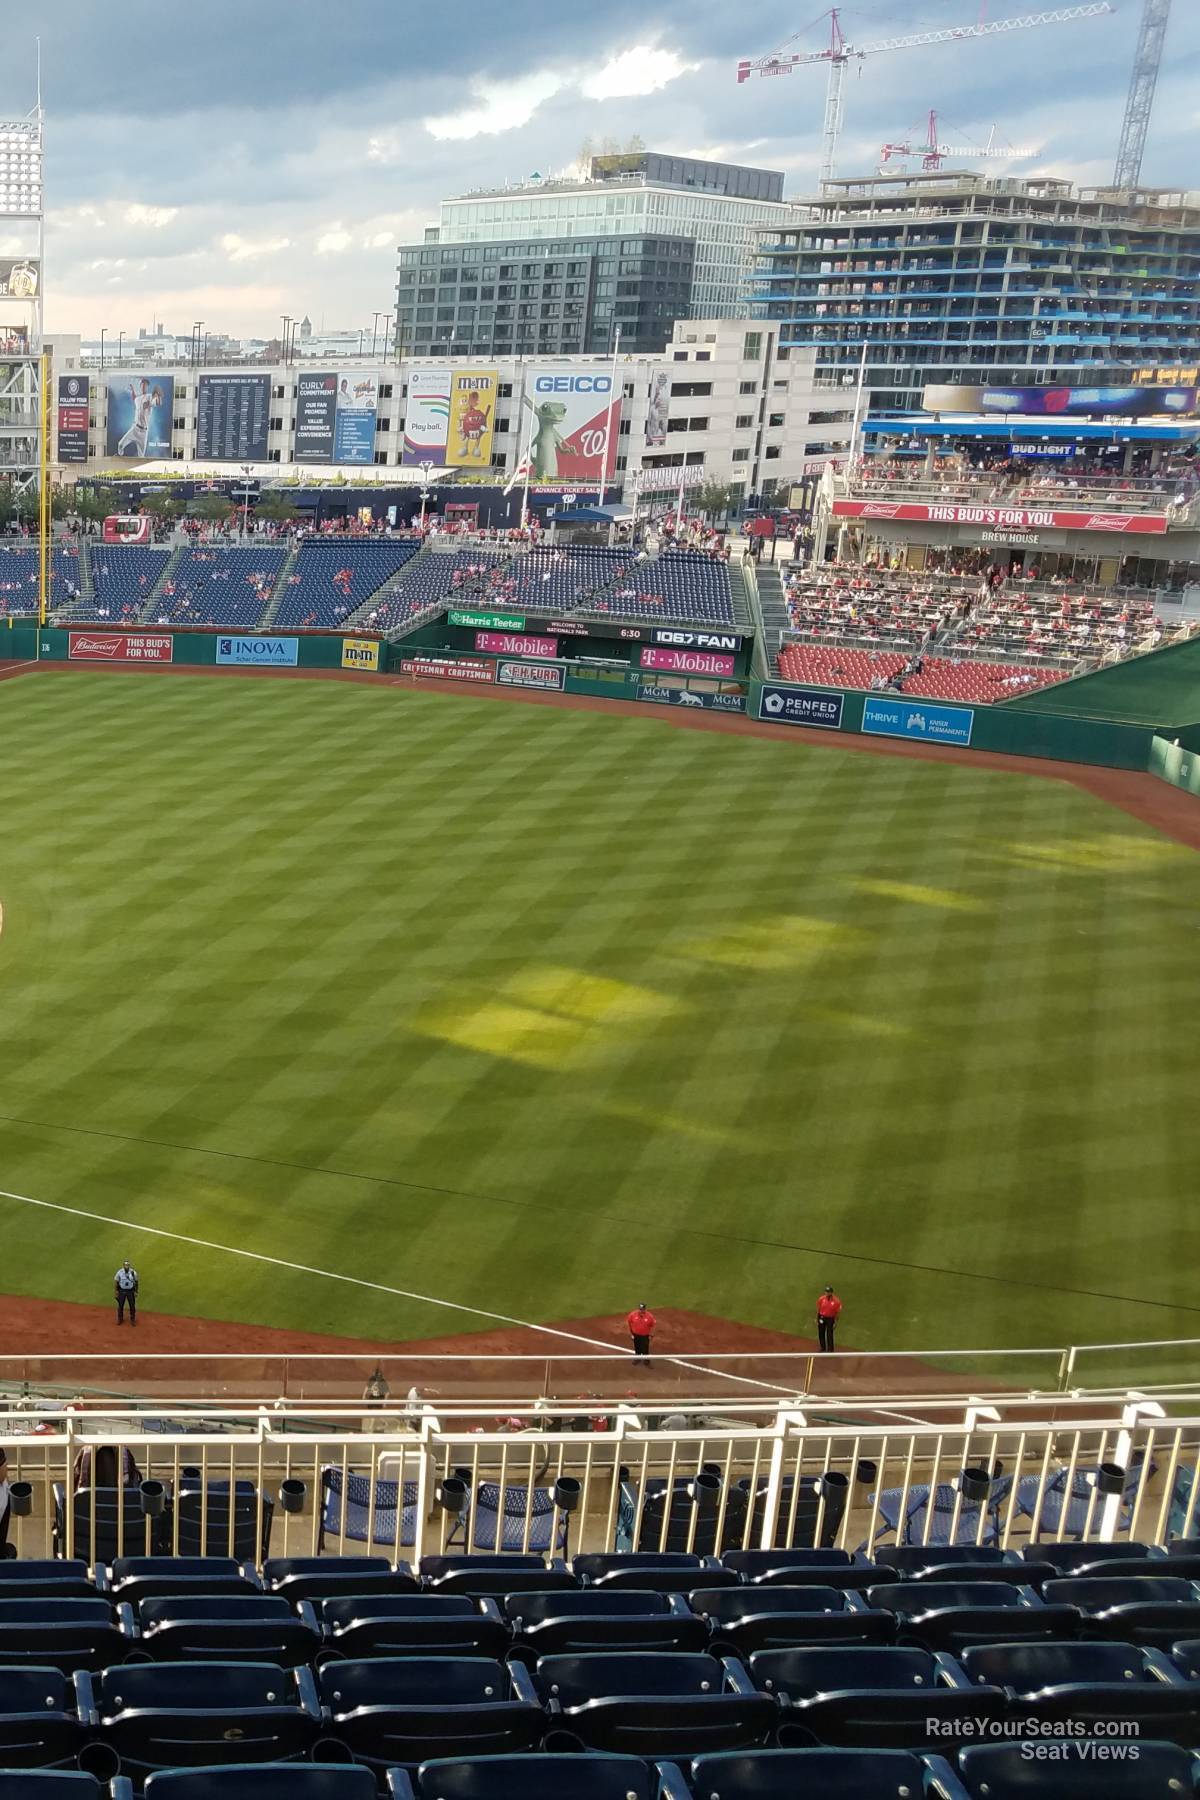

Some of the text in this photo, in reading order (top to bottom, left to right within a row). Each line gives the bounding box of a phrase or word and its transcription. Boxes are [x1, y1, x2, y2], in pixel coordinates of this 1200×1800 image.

[300, 381, 324, 390] CURLY
[536, 376, 612, 392] GEICO
[412, 423, 426, 431] Play
[1012, 444, 1036, 454] BUD
[1037, 446, 1071, 454] LIGHT
[928, 506, 1056, 526] THIS BUD'S FOR YOU.
[982, 532, 1039, 544] BREW HOUSE
[462, 615, 522, 628] Harris Teeter
[620, 629, 640, 638] 6:30
[78, 641, 116, 650] Budweiser
[126, 638, 170, 648] THIS BUD'S
[698, 634, 736, 648] FAN
[126, 648, 162, 658] FOR YOU.
[236, 641, 285, 654] INOVA
[448, 668, 492, 680] CRAFTSMAN
[643, 687, 741, 706] MGM MGM
[786, 698, 836, 711] PENFED
[785, 708, 835, 719] CREDIT UNION
[866, 711, 898, 724] THRIVE
